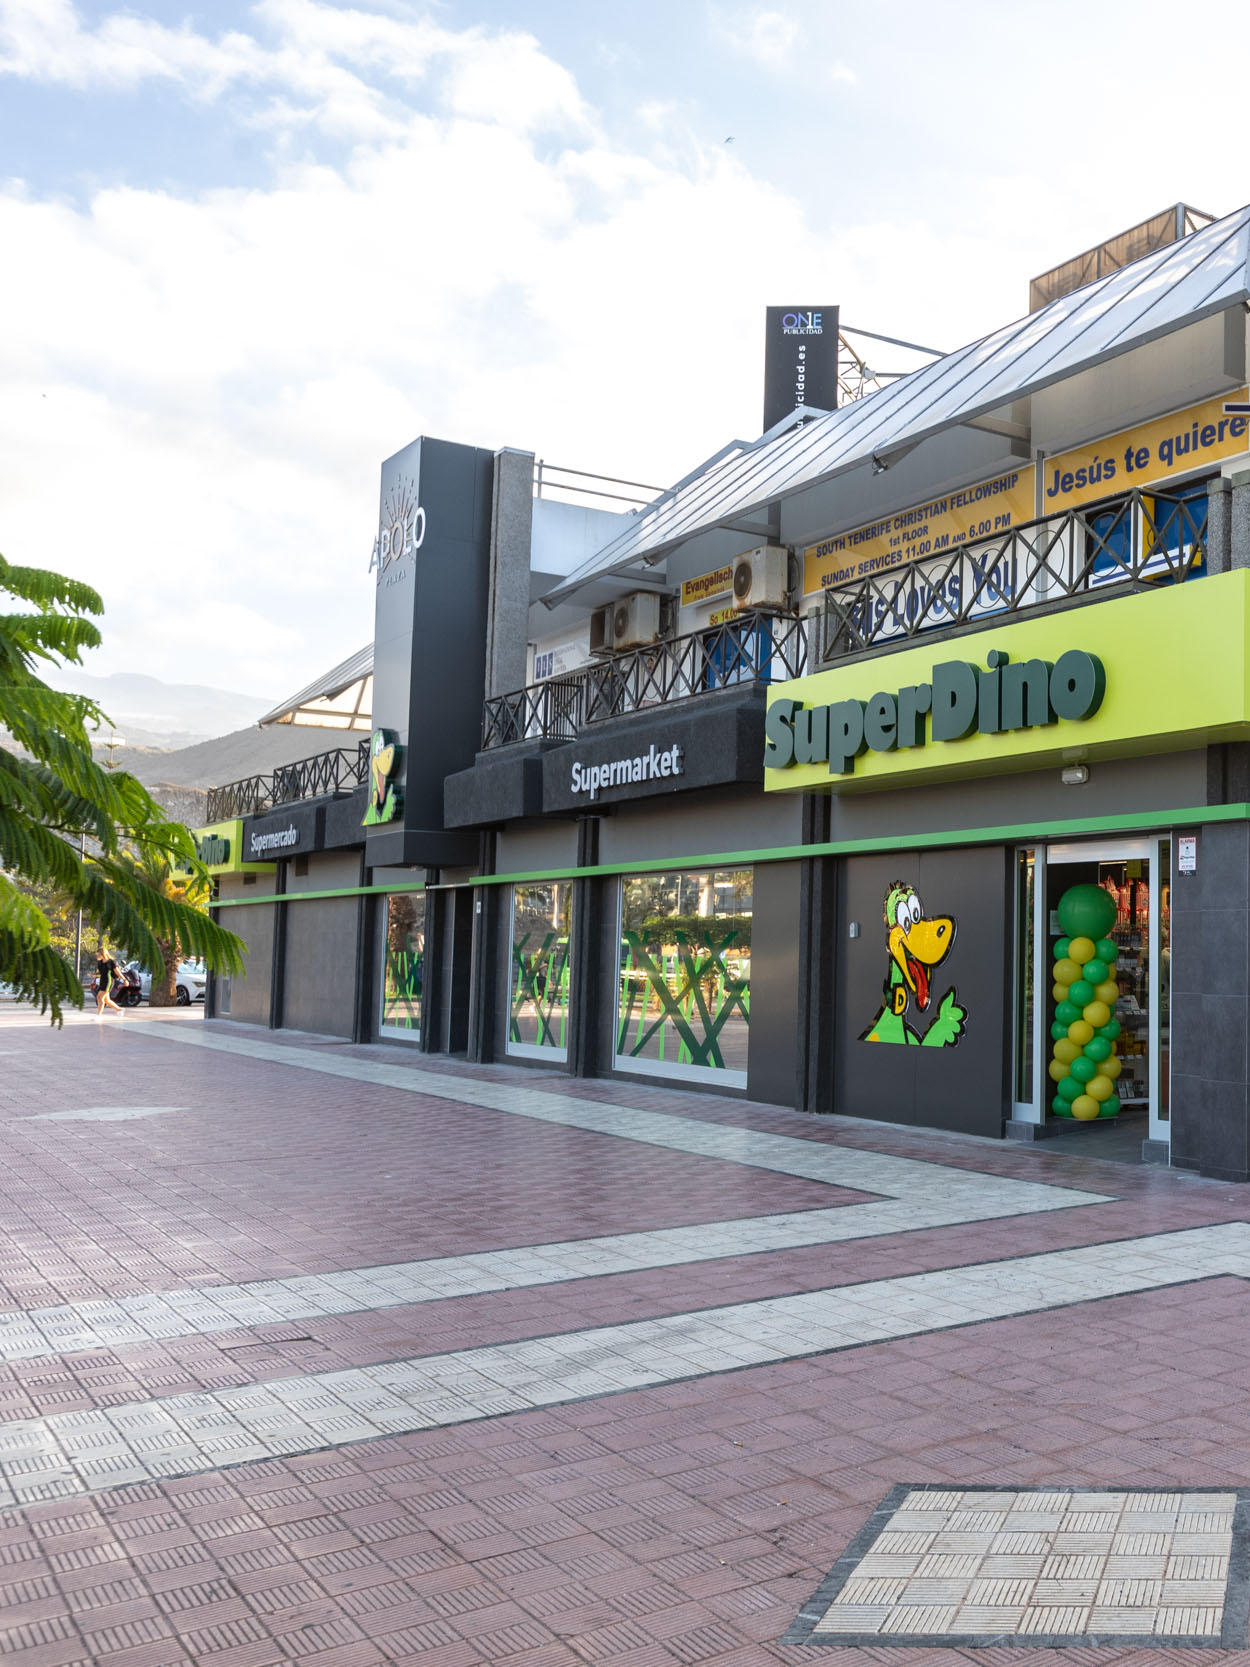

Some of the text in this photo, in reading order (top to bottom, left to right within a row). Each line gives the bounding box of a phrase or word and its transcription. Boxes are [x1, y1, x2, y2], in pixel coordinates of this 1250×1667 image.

[1047, 416, 1246, 497] Jesús te quiere
[368, 507, 425, 574] APOLO
[816, 474, 1019, 558] SOUTH TENERIFE CHRISTIAN FELLOWSHIP
[821, 512, 1011, 587] SUNDAY SERVICES 11.00 AM AND 6.00 PM
[889, 526, 929, 547] 1st FLOOR
[764, 649, 1106, 774] SuperDino
[571, 744, 681, 800] Supermarket
[251, 824, 297, 857] Supermercado
